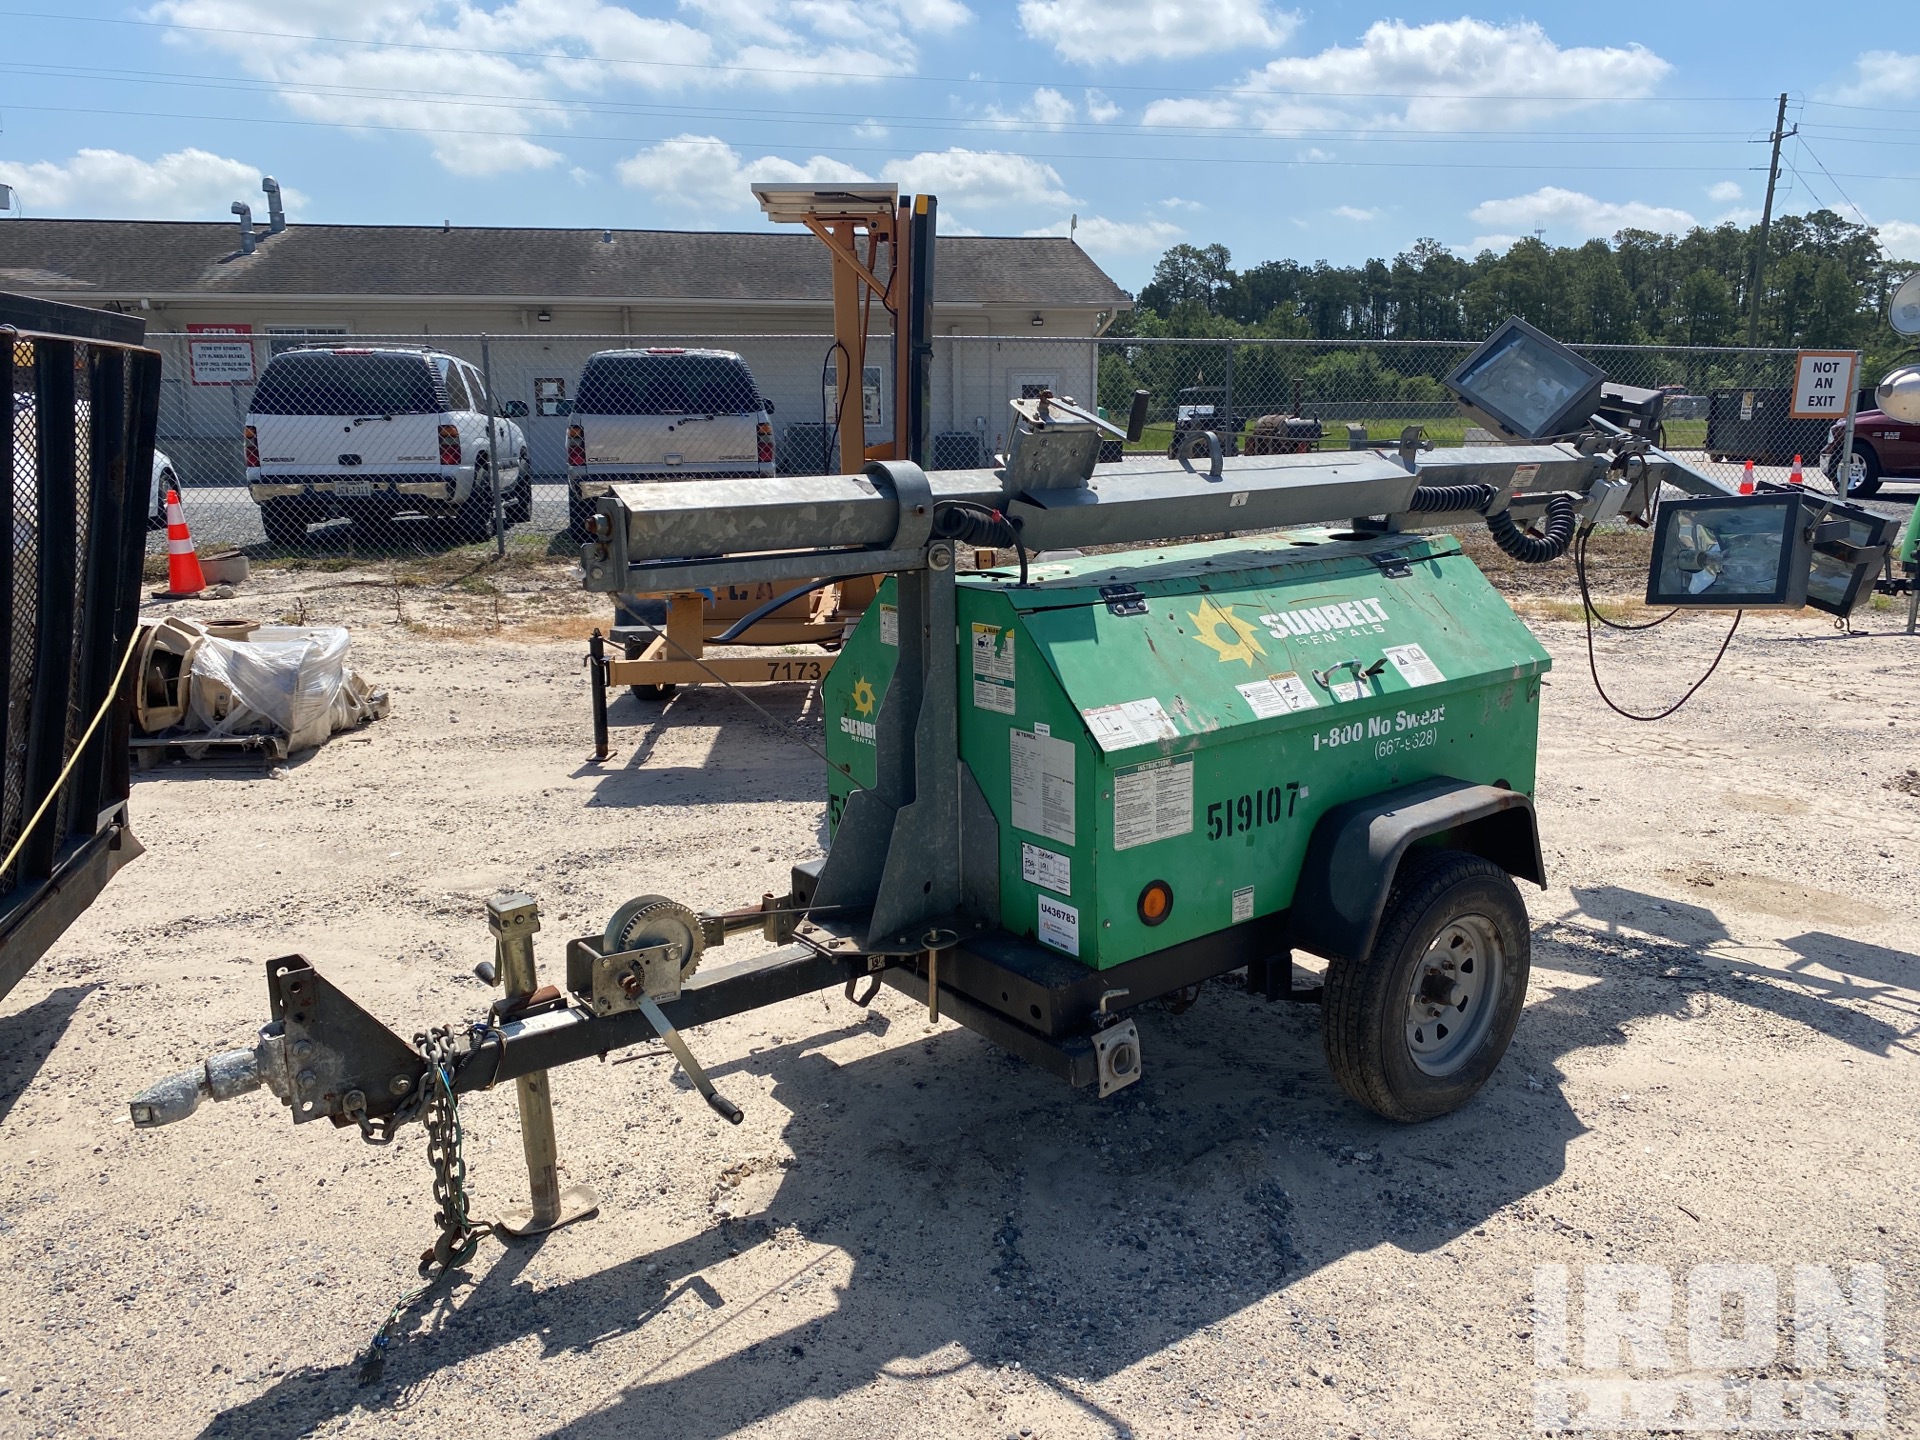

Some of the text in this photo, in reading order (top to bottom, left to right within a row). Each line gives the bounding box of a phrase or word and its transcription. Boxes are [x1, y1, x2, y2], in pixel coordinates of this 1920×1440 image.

[1813, 362, 1840, 373] NOT
[1814, 377, 1833, 389] AN
[1808, 395, 1836, 407] EXIT
[1258, 597, 1391, 639] SUNBELT
[1294, 623, 1386, 646] RENTALS
[767, 661, 823, 681] 7173
[840, 716, 876, 740] SUNB
[1312, 703, 1446, 752] 1-800 No Sweat
[1207, 780, 1300, 842] 519107
[1041, 903, 1076, 925] U436783
